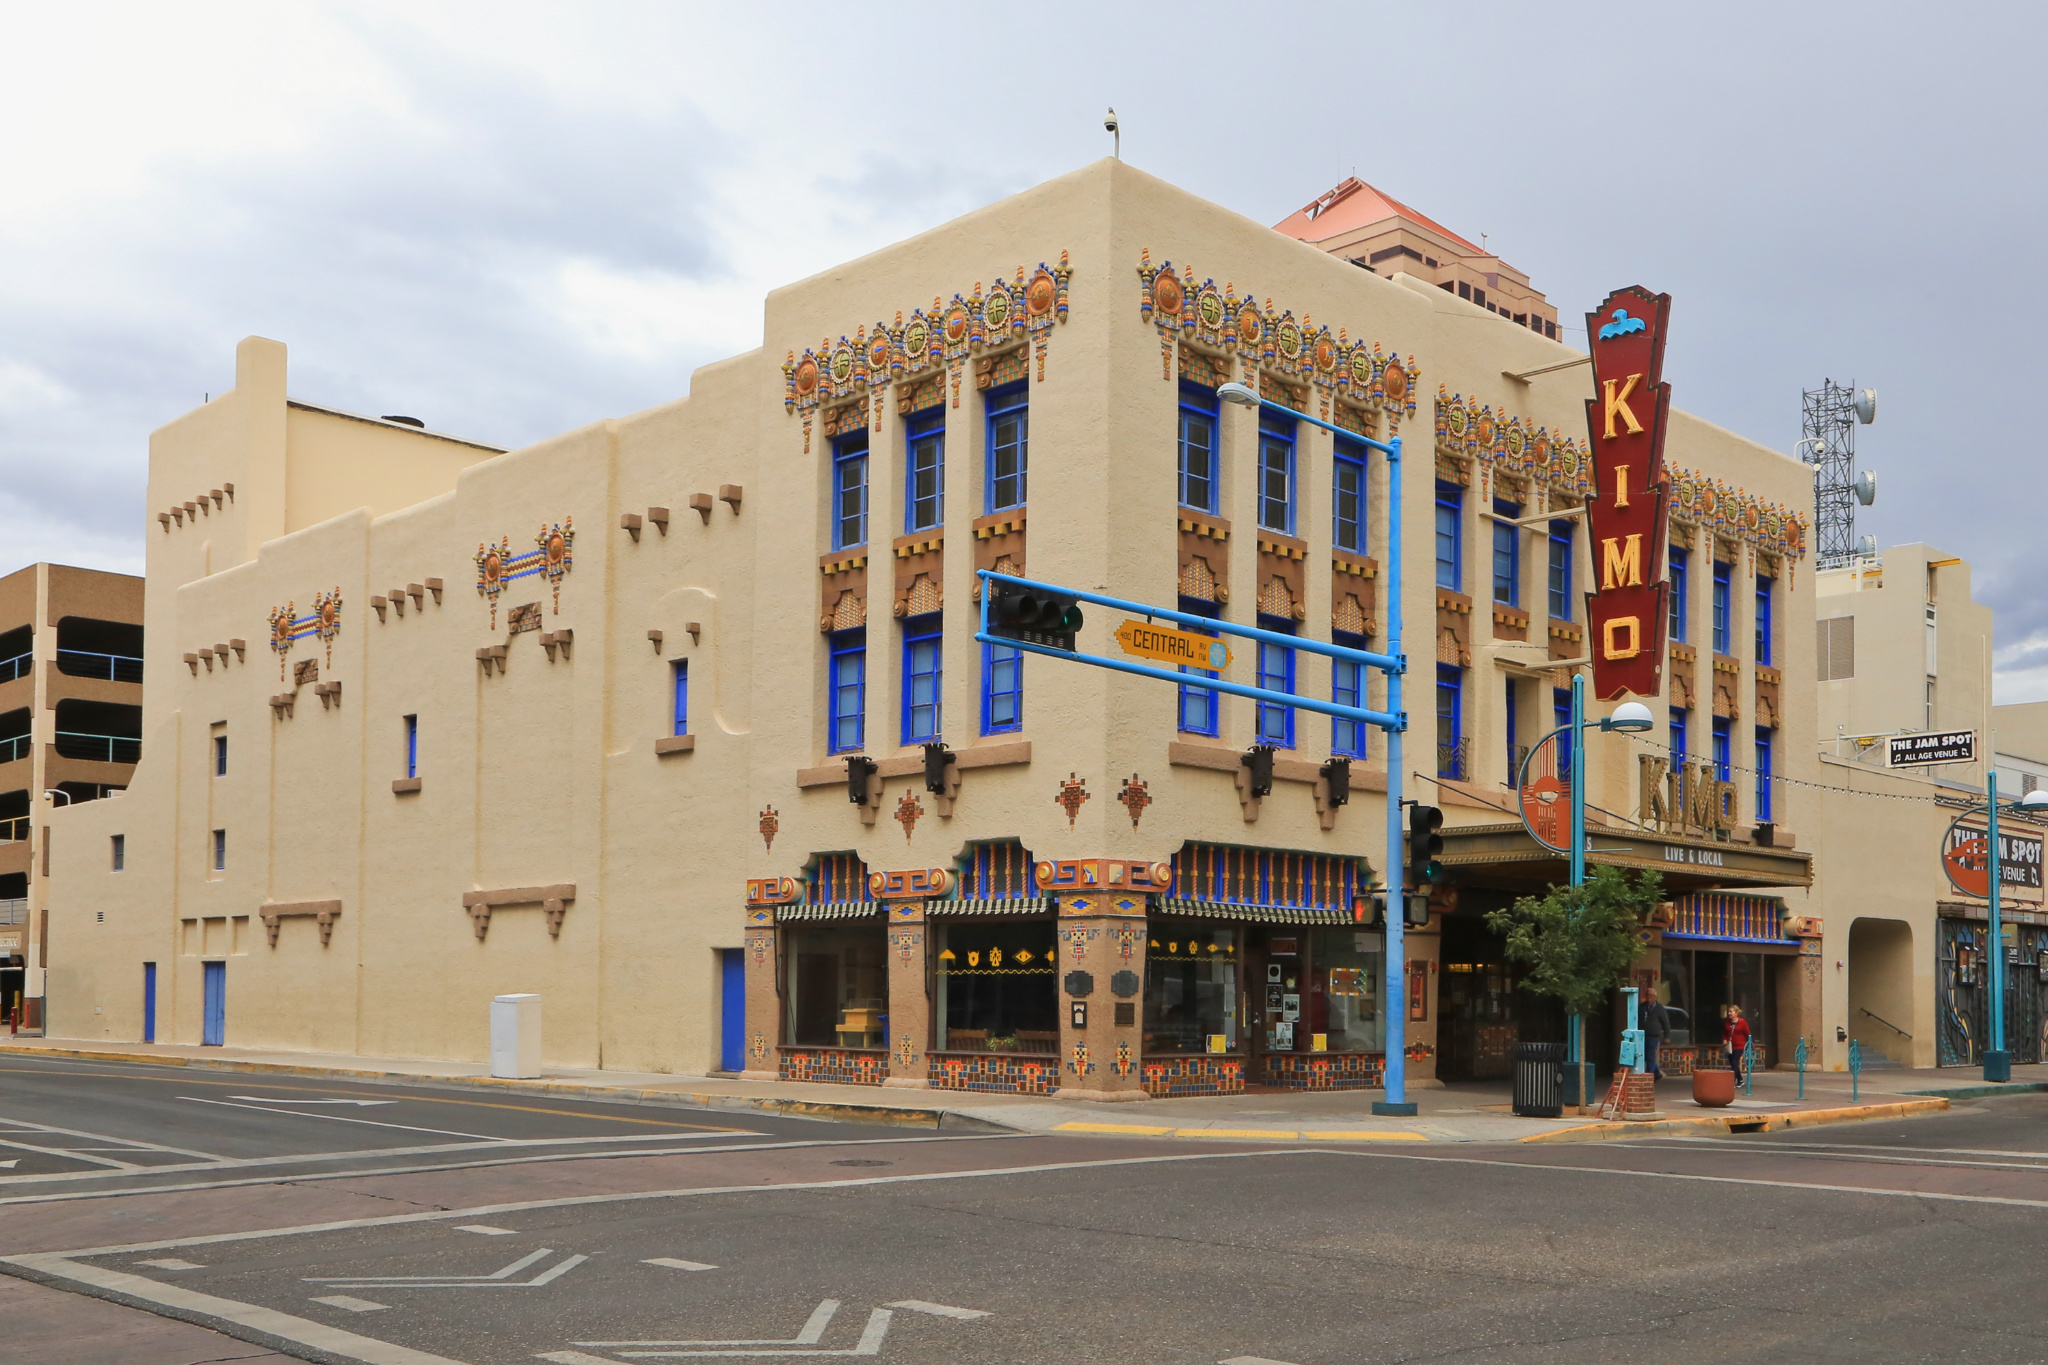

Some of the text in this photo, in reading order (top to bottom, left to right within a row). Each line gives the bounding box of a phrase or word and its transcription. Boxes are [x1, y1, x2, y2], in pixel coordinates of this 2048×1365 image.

[1602, 373, 1644, 660] KIMO
[1133, 629, 1194, 658] CENTRAL
[1891, 734, 1972, 751] THE JAM SPOT
[1918, 752, 1932, 760] AGE
[1934, 749, 1958, 758] VENUE
[1666, 847, 1723, 866] LIVE & LOCAL
[2011, 839, 2041, 864] SPOT
[2002, 866, 2026, 882] VENUE
